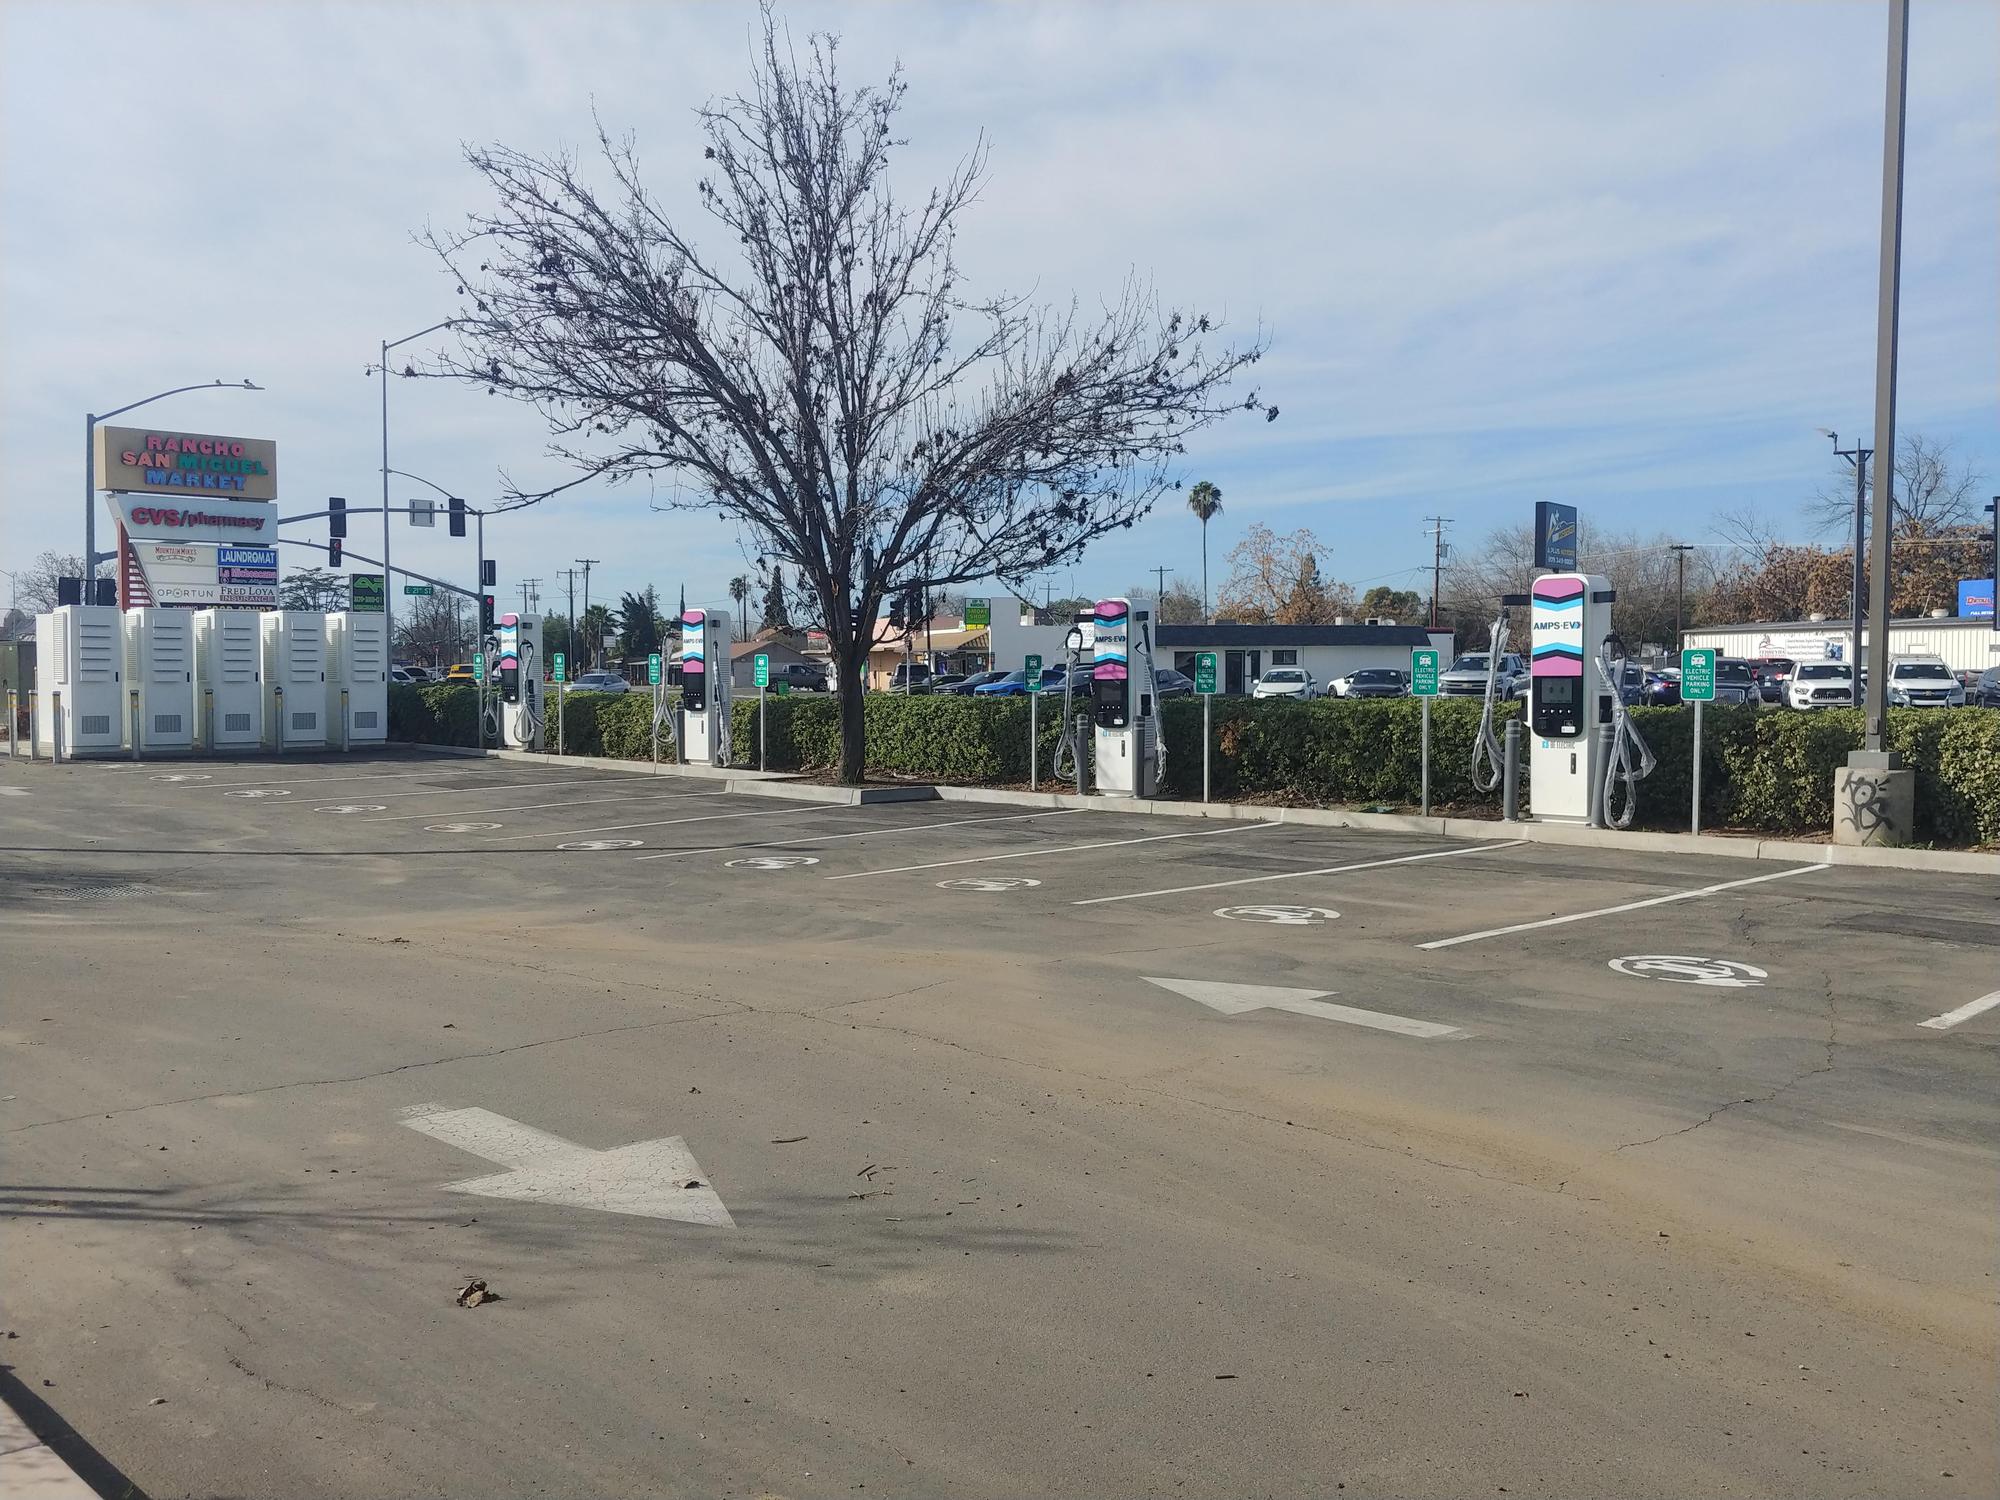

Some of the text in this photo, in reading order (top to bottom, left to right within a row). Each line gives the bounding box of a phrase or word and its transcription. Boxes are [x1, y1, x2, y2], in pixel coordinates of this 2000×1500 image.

[147, 435, 246, 457] RANCHO
[121, 451, 268, 476] SAN MIGUEL
[145, 468, 247, 491] MARKET
[131, 507, 265, 530] CVS/pharmacy
[220, 550, 275, 564] LAUNDROMAT
[157, 587, 214, 598] OPORTUN
[221, 586, 274, 595] FRED LOYA
